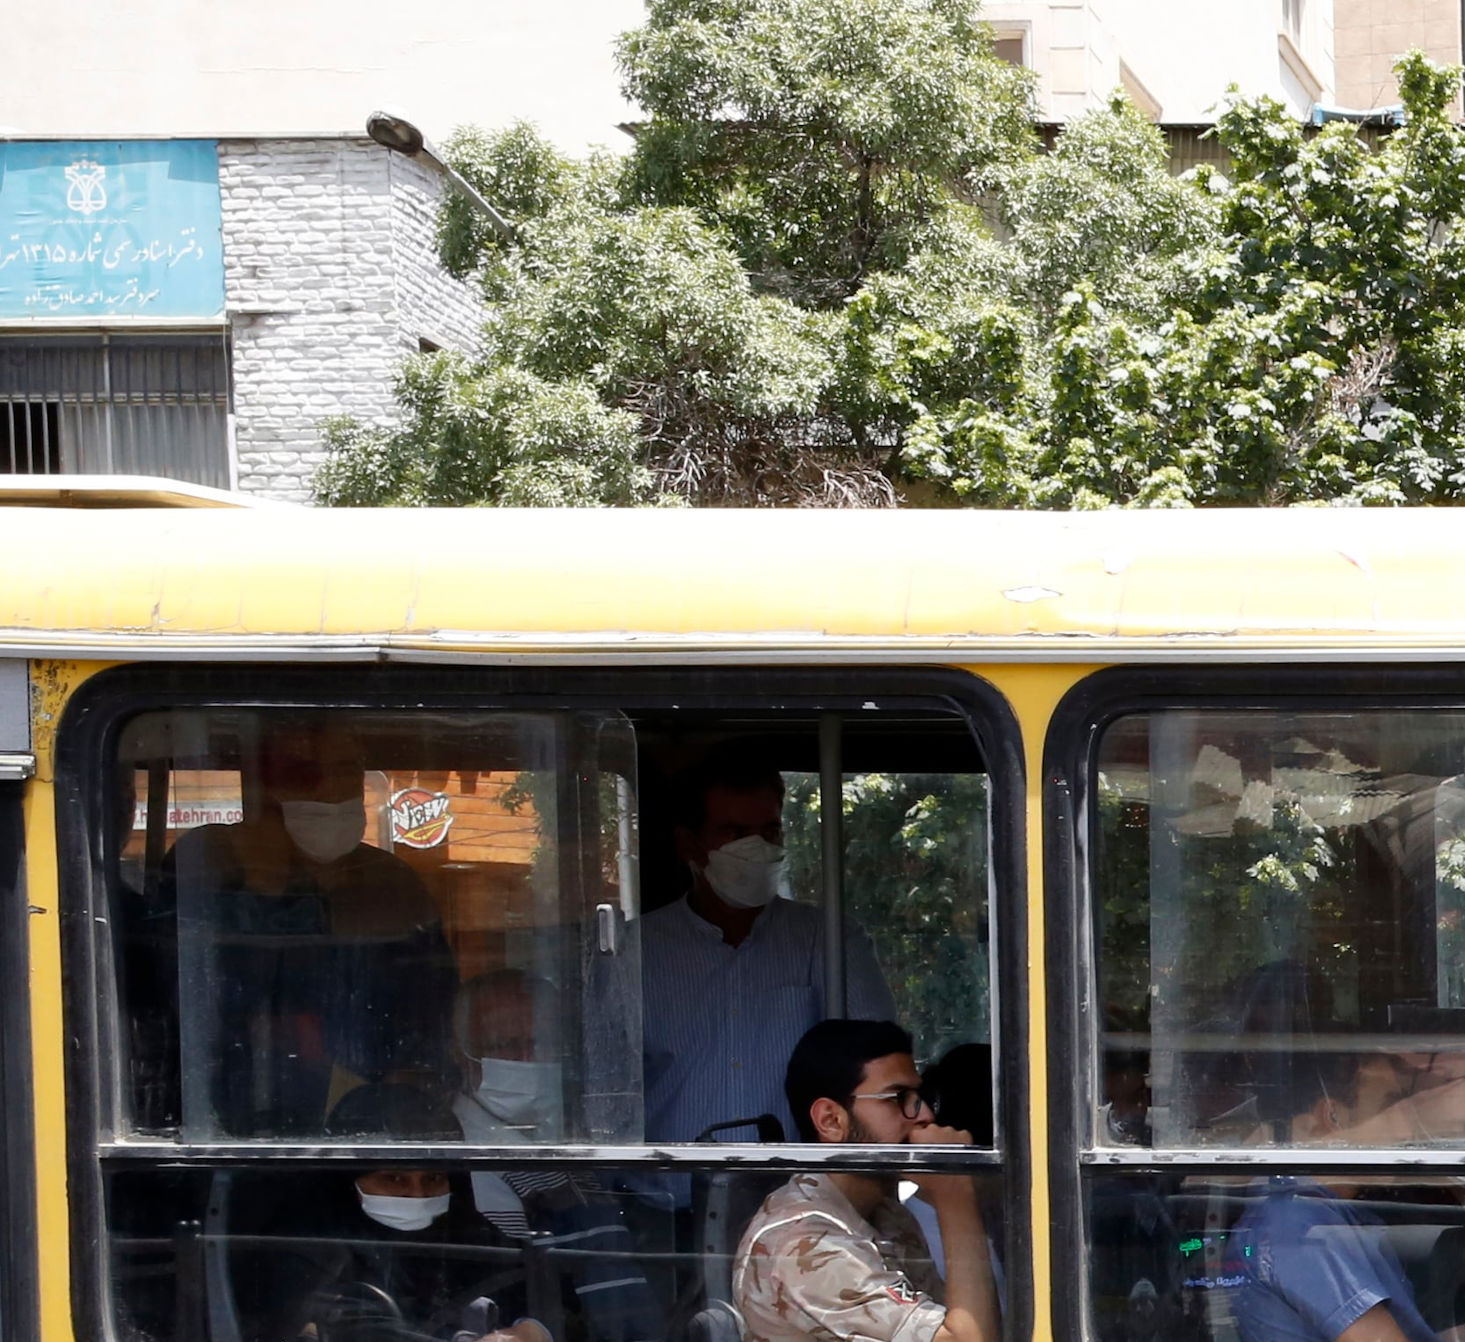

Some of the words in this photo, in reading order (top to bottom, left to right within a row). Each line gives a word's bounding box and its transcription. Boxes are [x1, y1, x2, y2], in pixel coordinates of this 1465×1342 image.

[21, 242, 67, 263] ۱۳۱۵
[69, 232, 102, 262] شماره
[169, 227, 204, 268] دفتر
